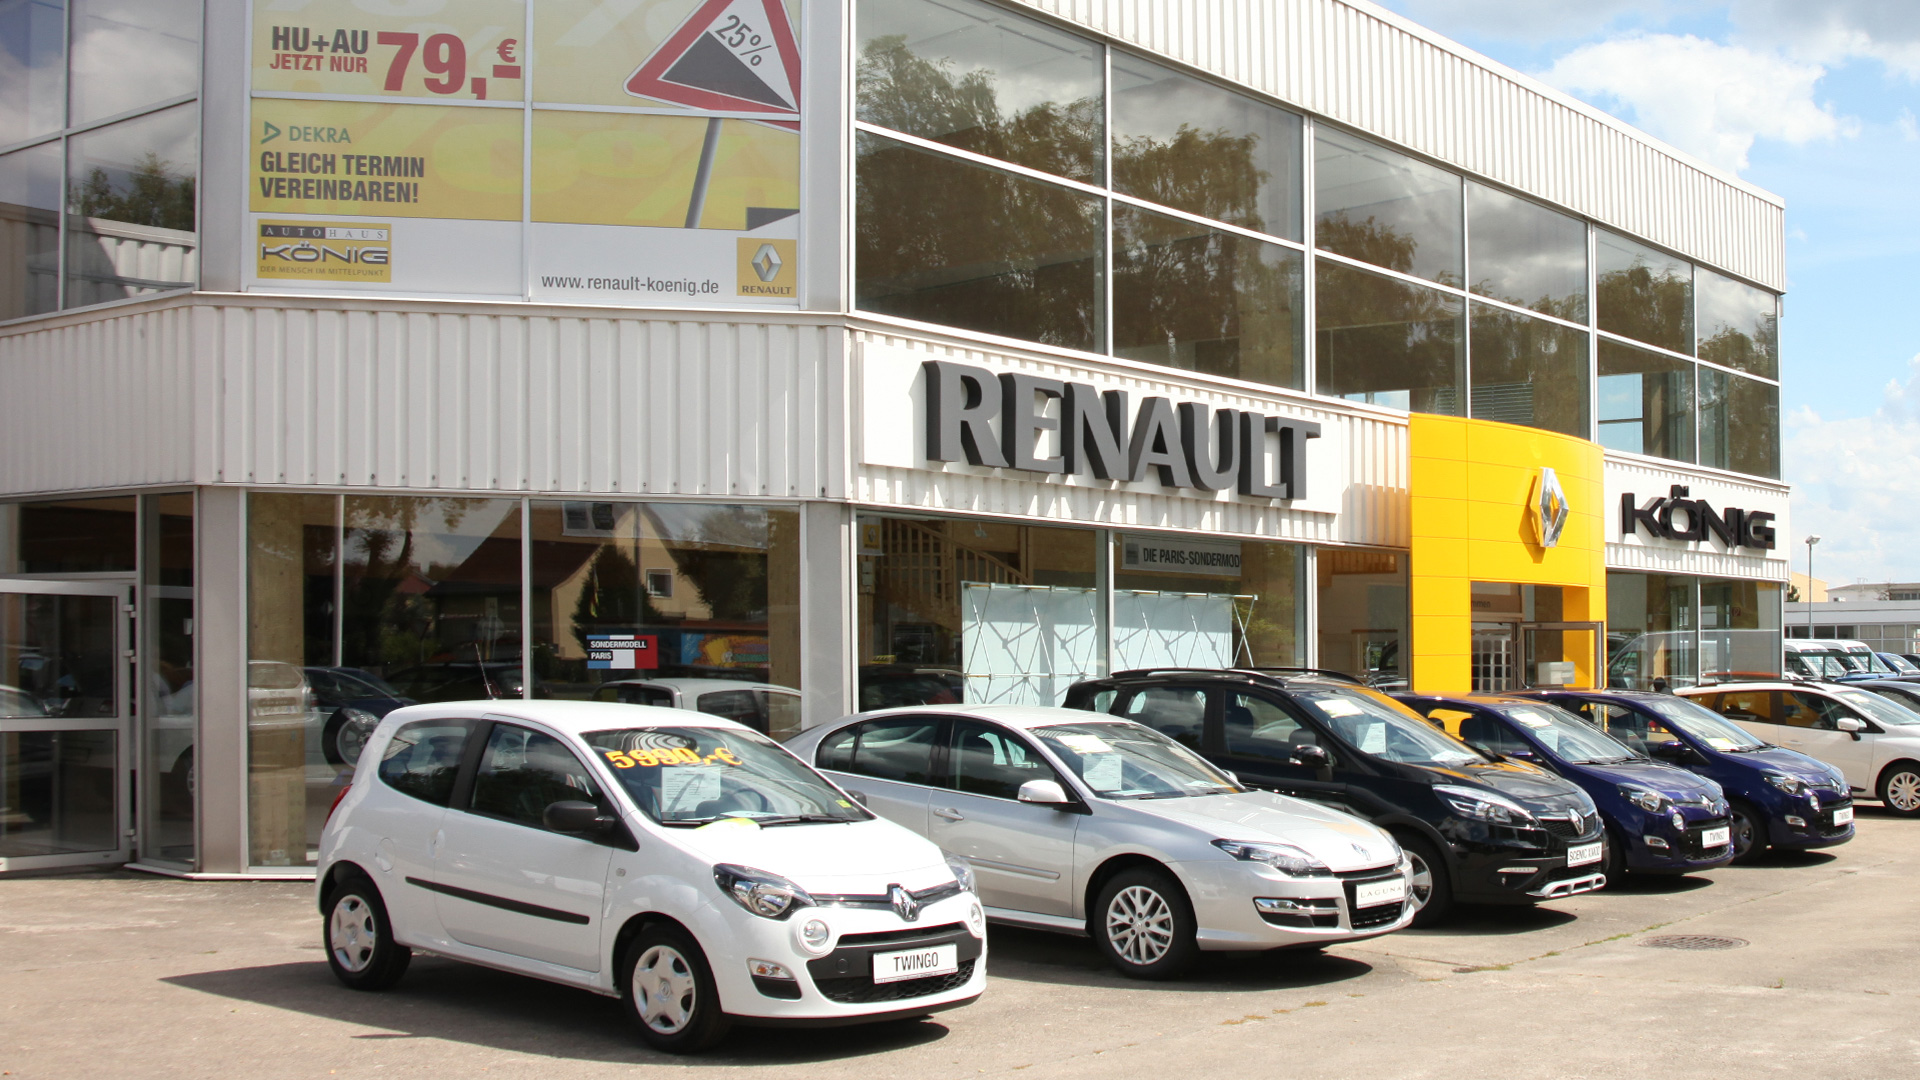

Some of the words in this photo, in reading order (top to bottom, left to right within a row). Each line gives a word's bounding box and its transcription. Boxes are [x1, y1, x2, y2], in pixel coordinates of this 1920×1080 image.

[271, 25, 369, 55] HU+AU
[714, 14, 772, 67] 25%
[269, 53, 324, 71] JETZT
[329, 56, 368, 73] NUR
[289, 126, 351, 143] DEKRA
[260, 151, 336, 174] GLEICH
[342, 154, 424, 178] TERMIN
[259, 177, 418, 204] VEREINBAREN!
[261, 240, 389, 264] KÖNIG
[278, 266, 313, 274] MENSCH
[328, 268, 384, 277] MITTELPUNKT
[742, 285, 792, 295] RENAULT
[922, 360, 1322, 501] RENAULT
[1621, 484, 1776, 549] KÖNIG
[1143, 548, 1158, 563] DIE
[1160, 549, 1241, 568] PARIS-SONDERMOD
[590, 640, 647, 649] SONDERMODELL
[591, 652, 612, 660] PARIS
[1360, 886, 1402, 898] LAGUNA
[893, 952, 939, 972] TWINGO
